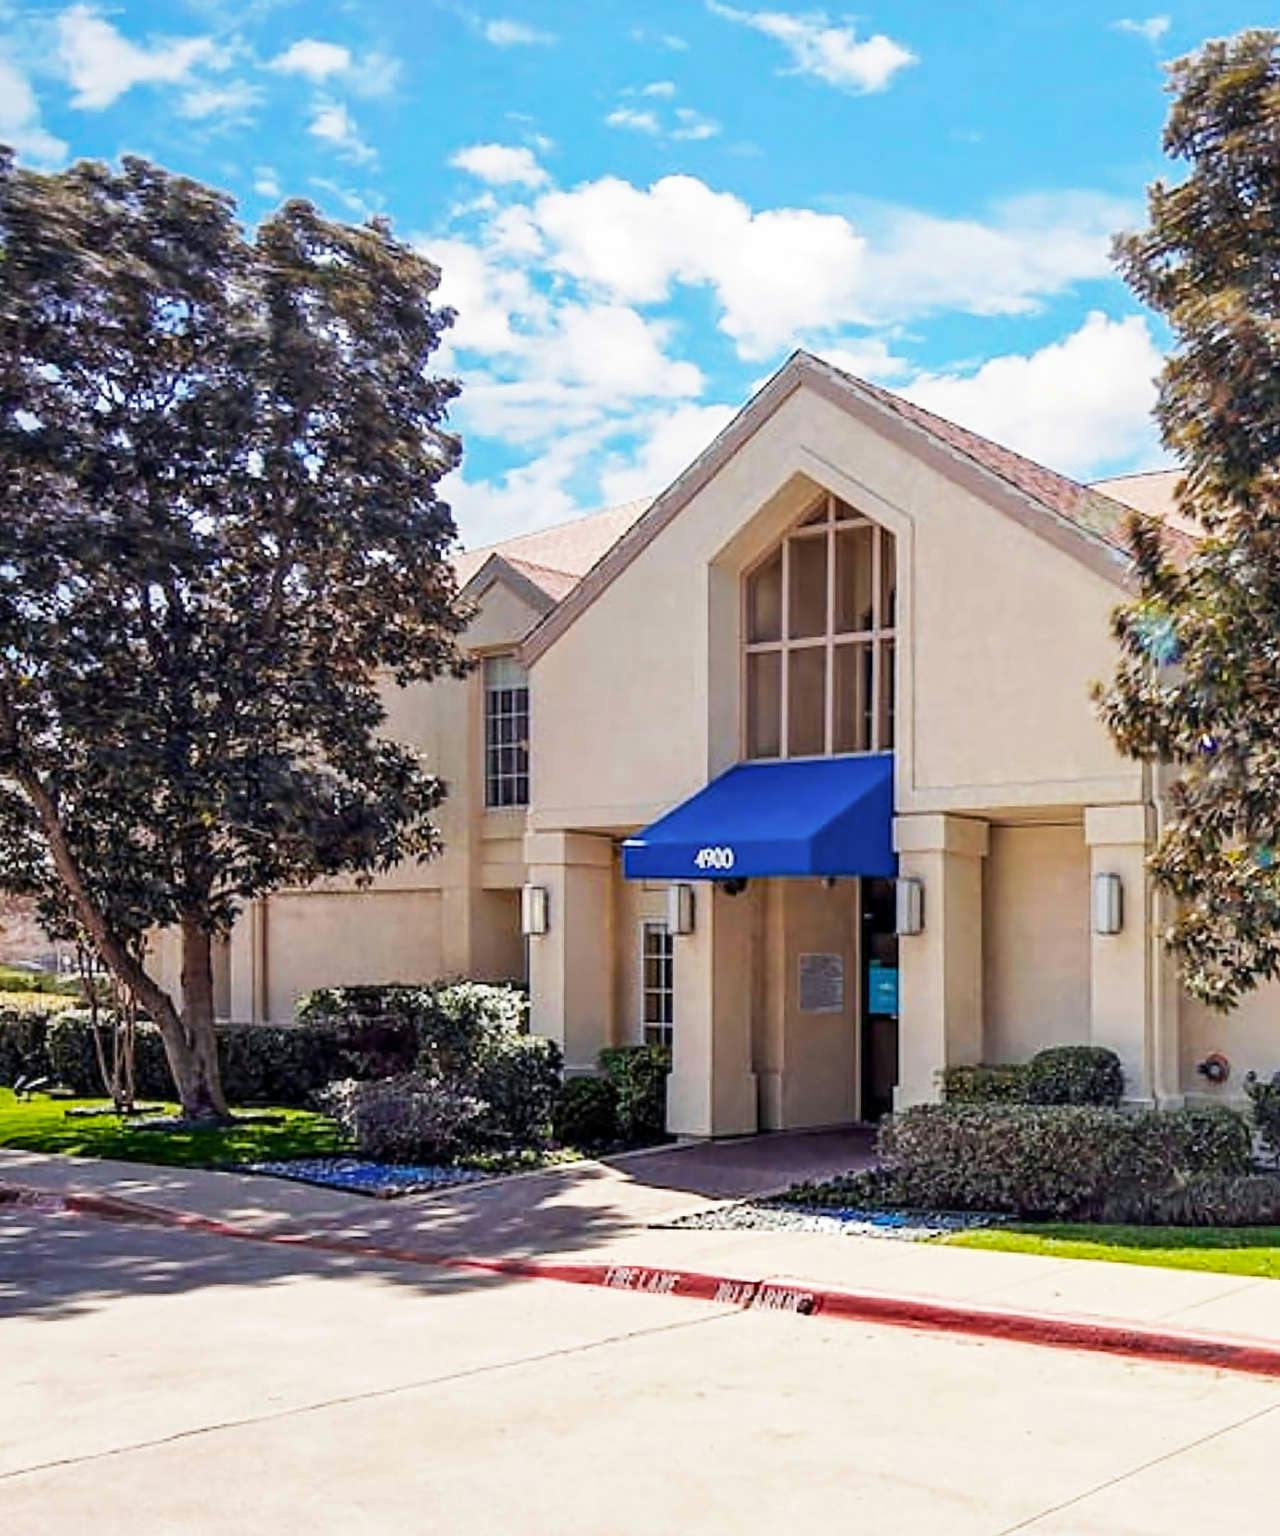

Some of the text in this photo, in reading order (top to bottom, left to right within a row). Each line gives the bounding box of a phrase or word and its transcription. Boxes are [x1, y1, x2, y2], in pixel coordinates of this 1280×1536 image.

[694, 847, 734, 869] 4900
[604, 1266, 680, 1295] FIRE LANE
